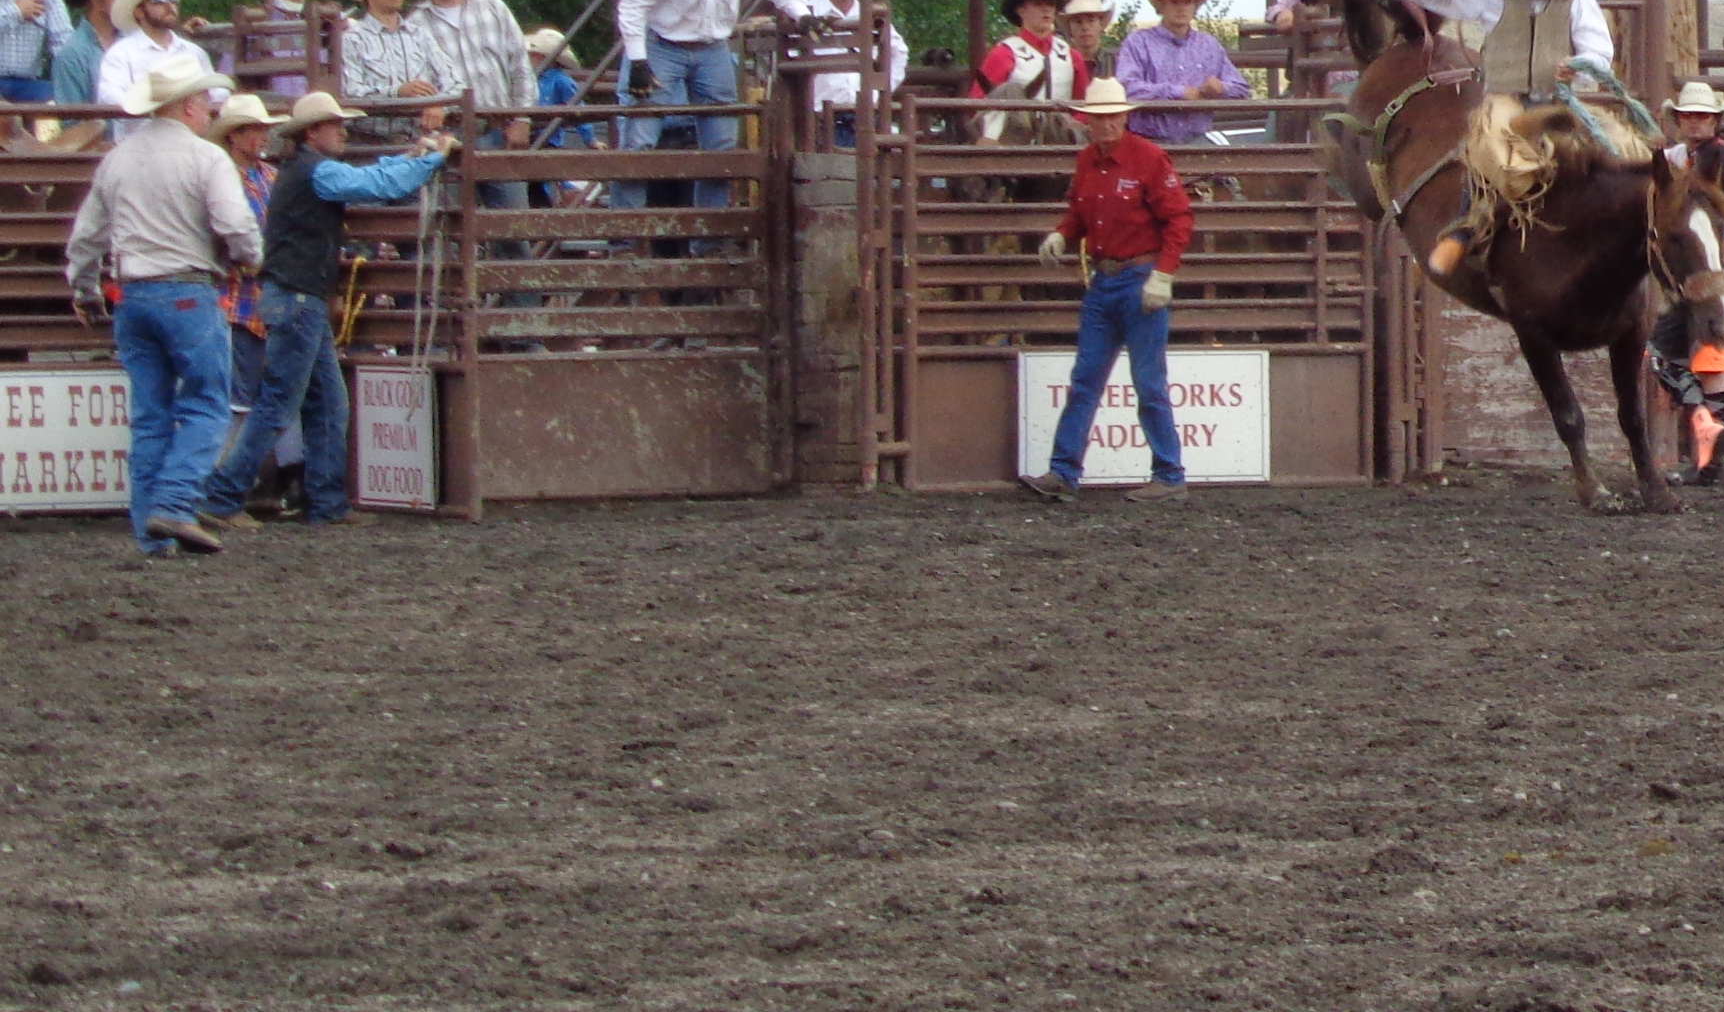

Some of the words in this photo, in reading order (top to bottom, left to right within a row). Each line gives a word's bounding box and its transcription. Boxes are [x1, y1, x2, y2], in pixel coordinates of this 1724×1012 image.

[68, 384, 129, 428] FOR
[1046, 384, 1136, 409] TEE
[1167, 382, 1243, 408] ORKS
[0, 449, 128, 493] ARKET
[367, 465, 391, 493] DOG
[393, 466, 424, 496] FOOD
